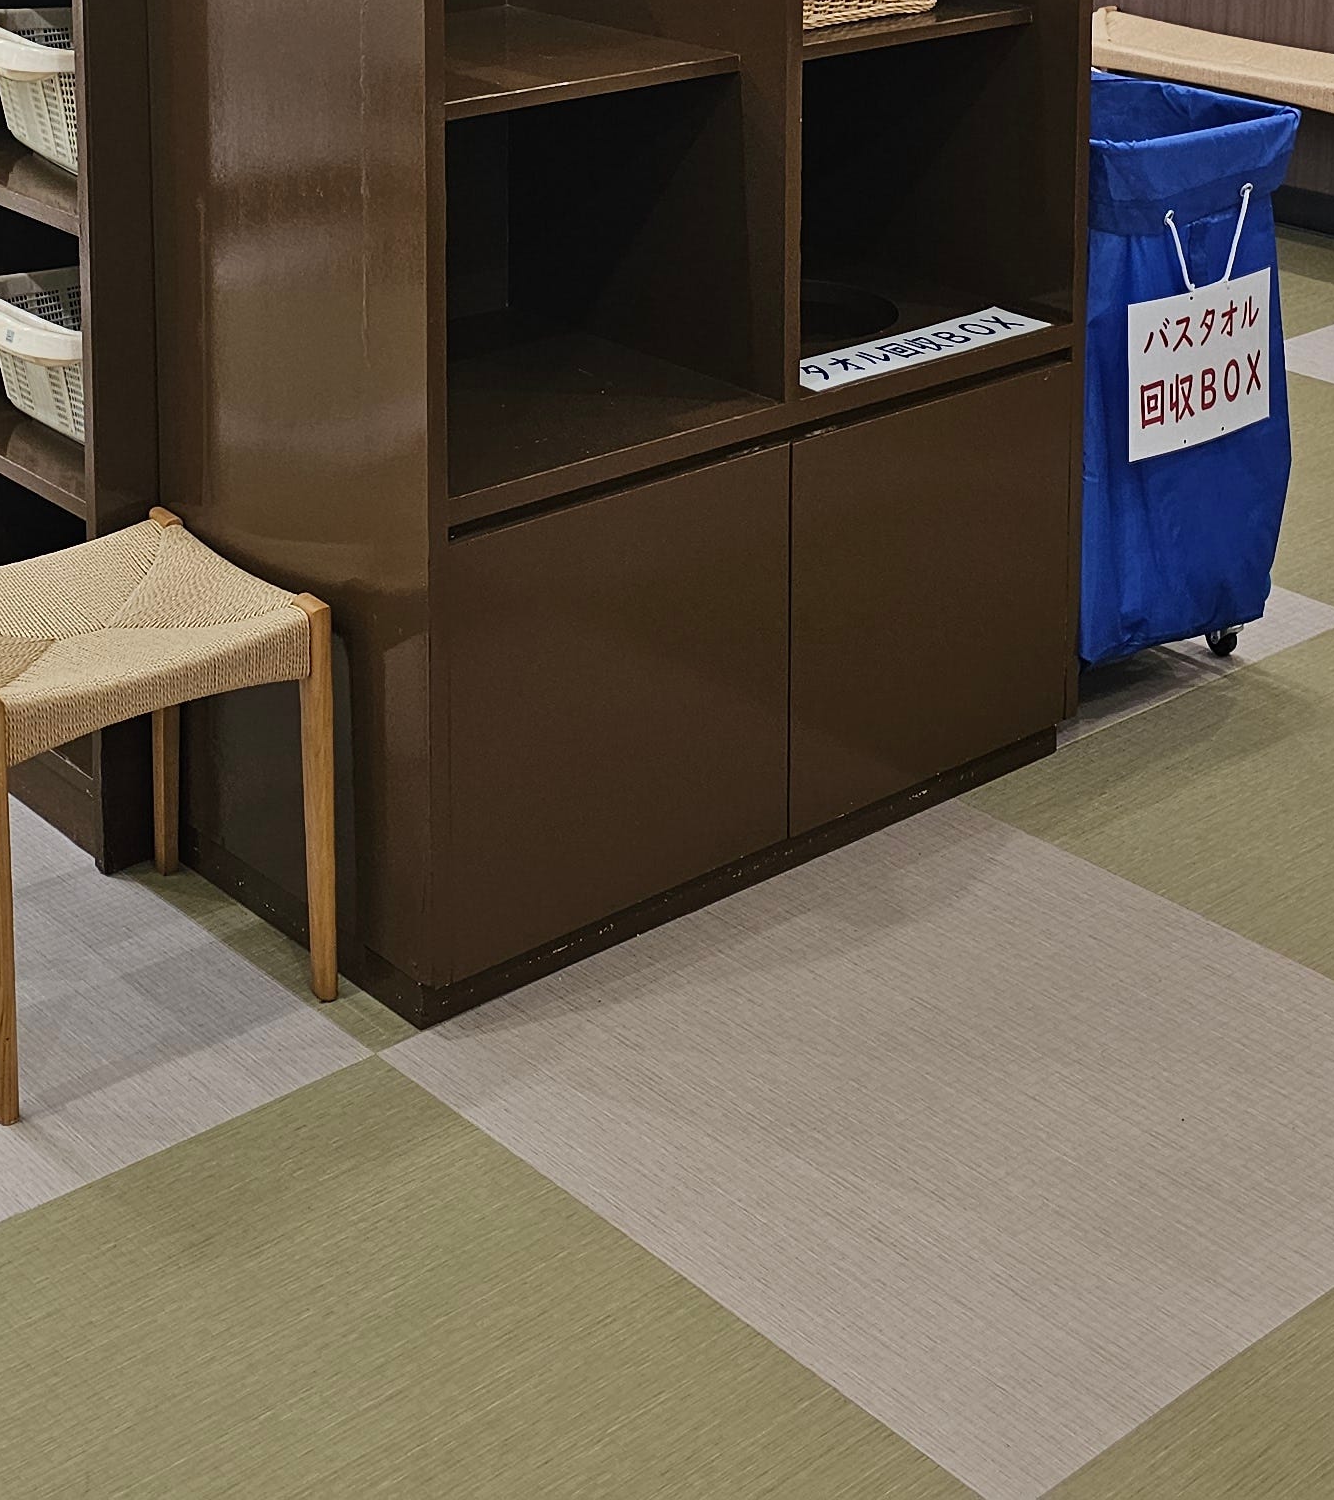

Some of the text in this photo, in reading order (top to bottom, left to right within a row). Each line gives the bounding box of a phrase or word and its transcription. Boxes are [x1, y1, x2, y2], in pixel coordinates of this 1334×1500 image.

[1143, 295, 1260, 354] バスタオル
[1140, 349, 1262, 429] 回収BOX
